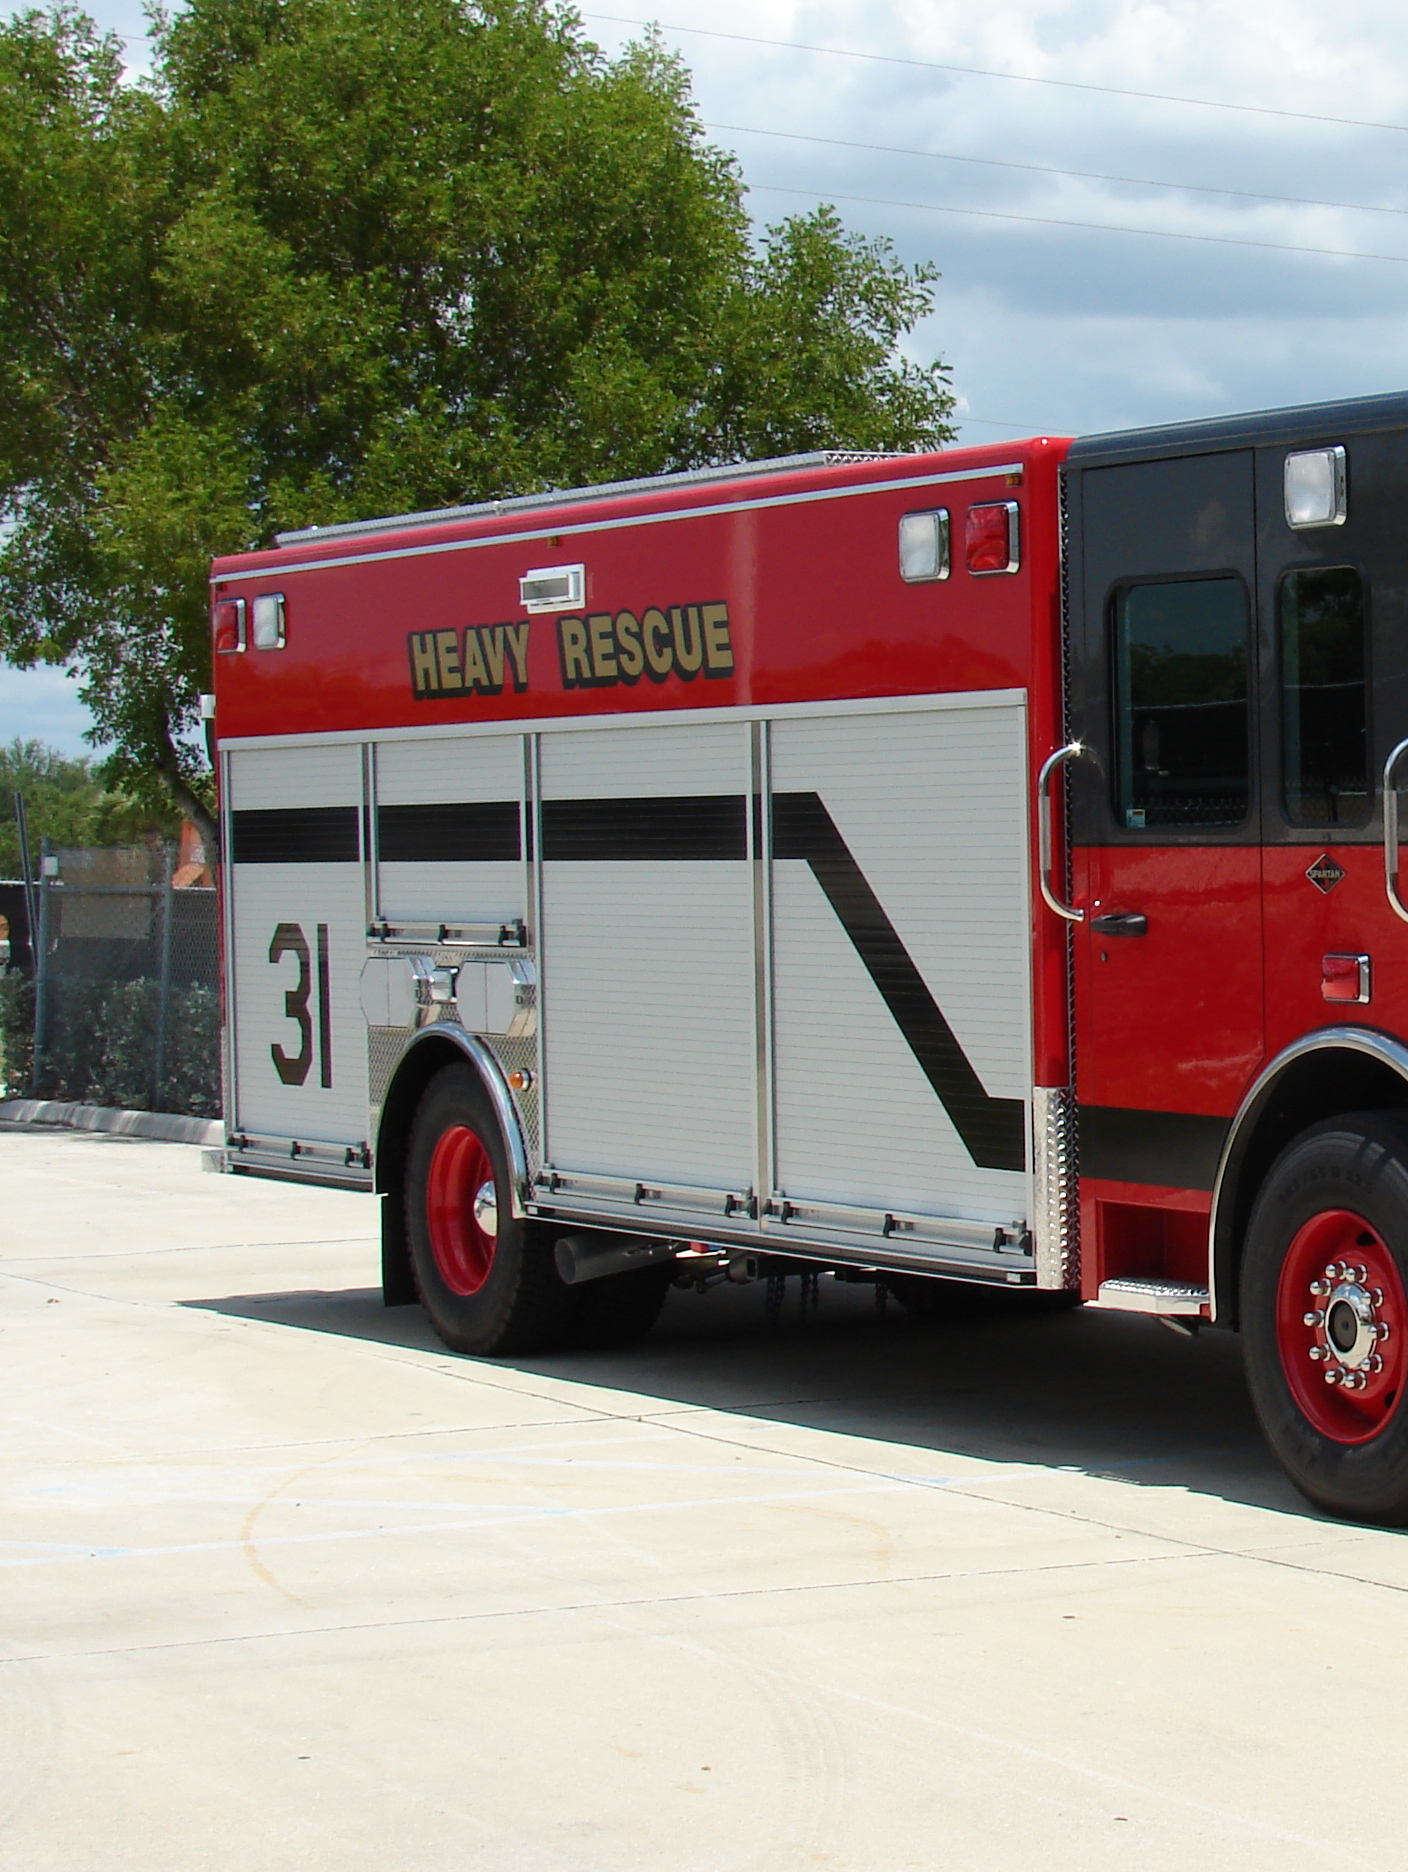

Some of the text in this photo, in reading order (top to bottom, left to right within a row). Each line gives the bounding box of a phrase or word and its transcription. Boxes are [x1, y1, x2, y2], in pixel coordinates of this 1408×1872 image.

[407, 600, 735, 700] HEAVY RESCUE
[1309, 869, 1341, 879] SPARTAN
[268, 923, 332, 1089] 31
